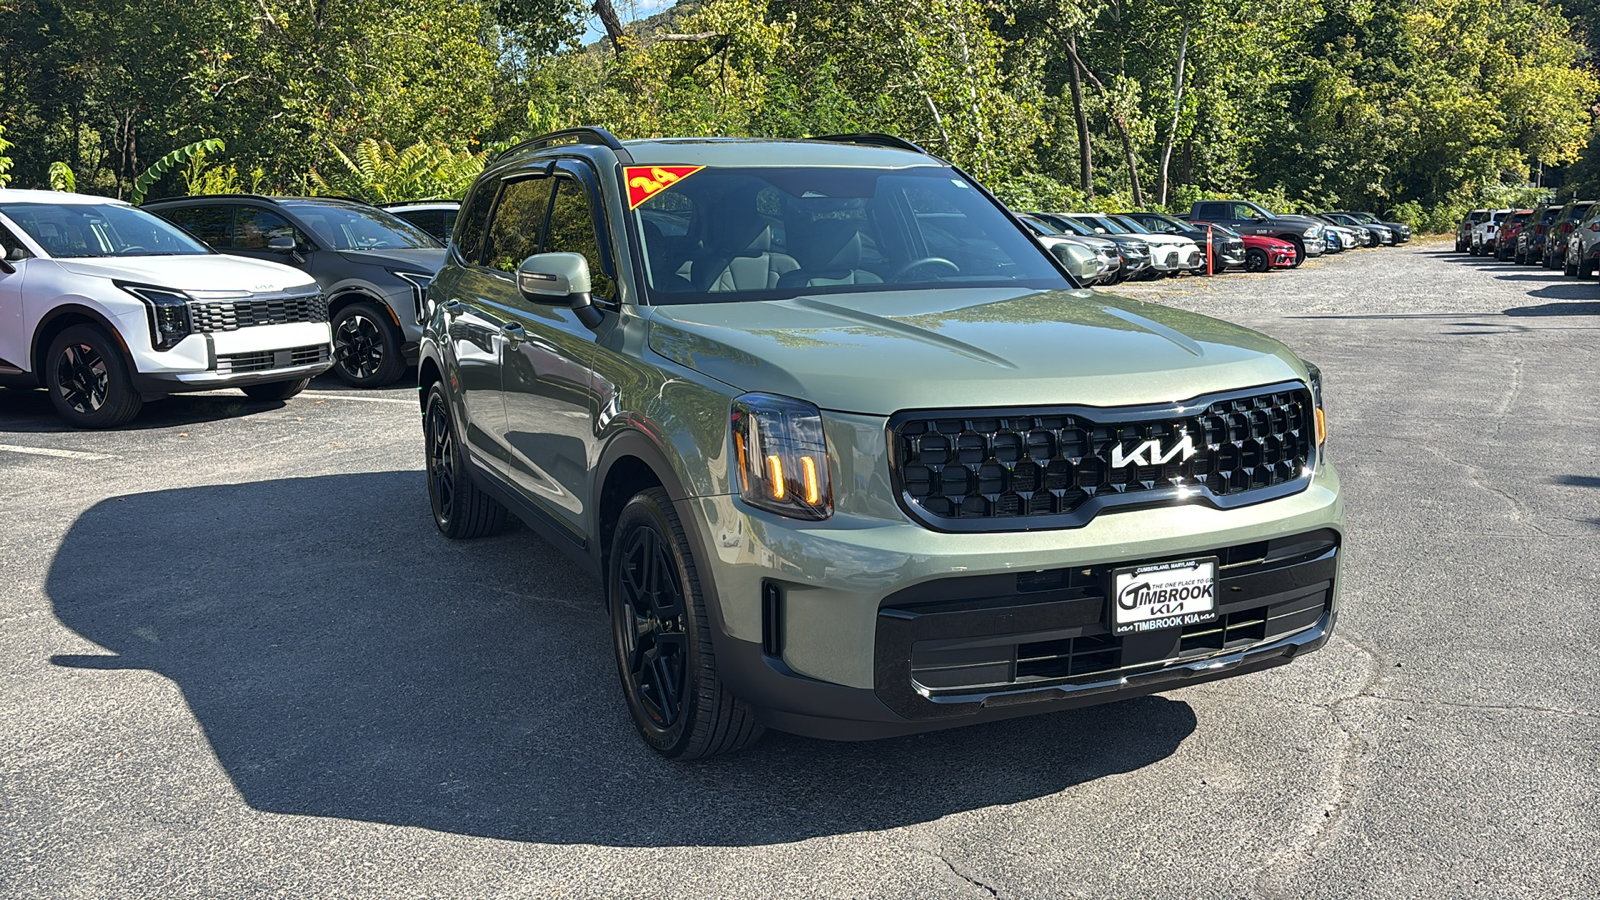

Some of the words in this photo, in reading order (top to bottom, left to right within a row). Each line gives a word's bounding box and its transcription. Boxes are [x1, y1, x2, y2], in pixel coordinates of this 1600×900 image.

[629, 168, 680, 194] 24
[1111, 434, 1193, 469] KIA
[1170, 561, 1196, 569] MARYLAND
[1177, 579, 1195, 587] PLACE
[1118, 582, 1214, 610] TIMBROOK
[1150, 602, 1184, 616] KIA
[1133, 616, 1182, 632] TIMBROOK
[1184, 614, 1199, 624] KIA
